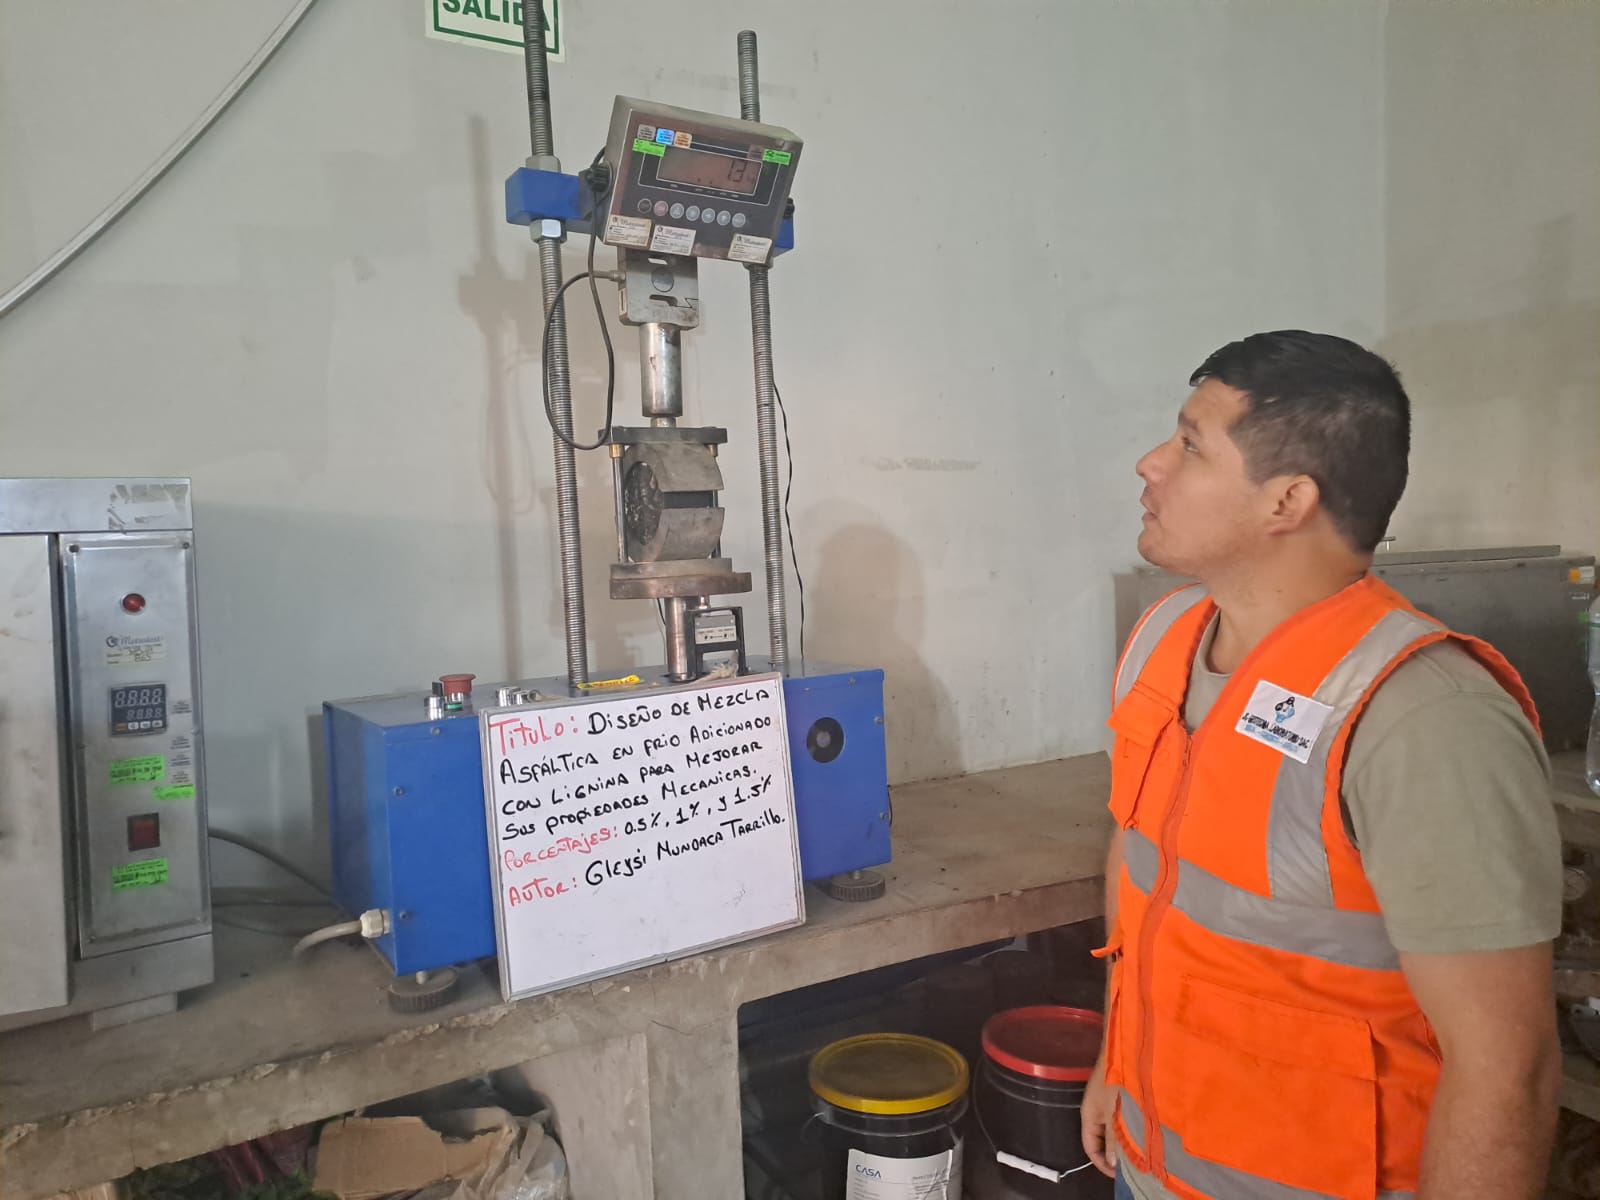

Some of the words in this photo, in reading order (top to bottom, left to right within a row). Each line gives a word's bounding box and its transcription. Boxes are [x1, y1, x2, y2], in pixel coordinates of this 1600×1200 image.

[671, 701, 691, 716] DE
[697, 689, 770, 711] MEZCLA
[612, 745, 633, 760] EN
[502, 798, 541, 816] CON
[686, 741, 763, 768] MEJORAR
[734, 774, 771, 805] 1.5%
[508, 877, 578, 907] AUTOR:
[855, 1164, 882, 1179] CASA
